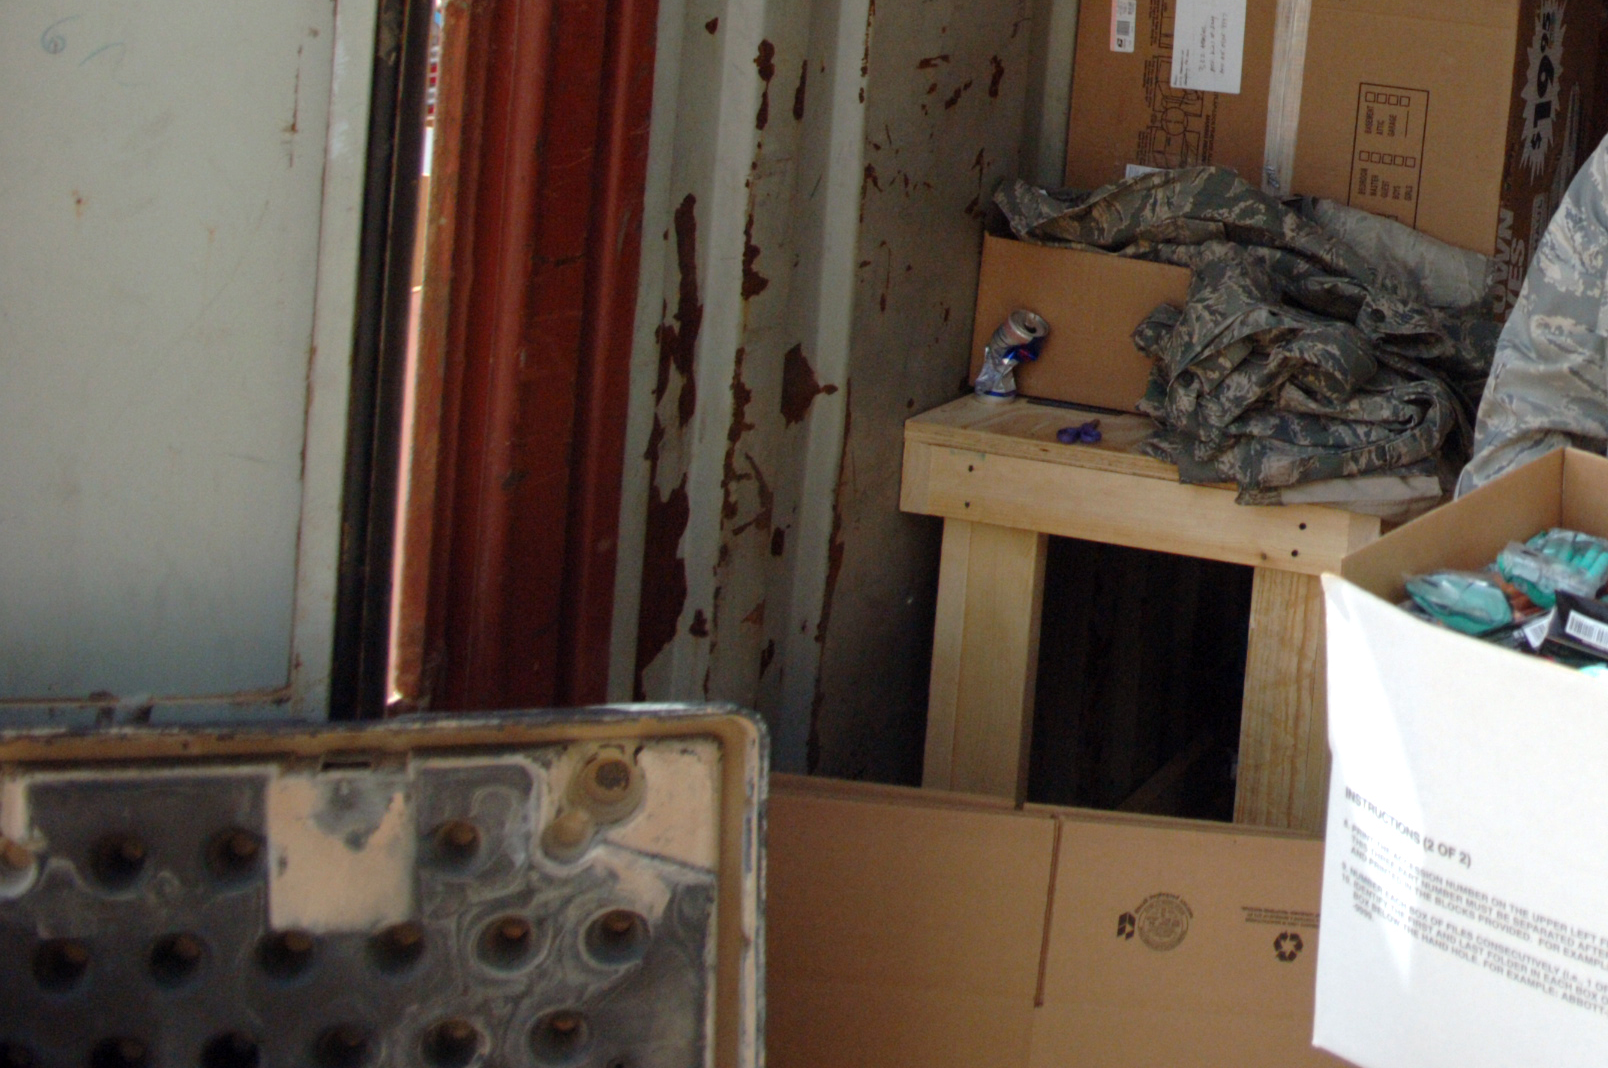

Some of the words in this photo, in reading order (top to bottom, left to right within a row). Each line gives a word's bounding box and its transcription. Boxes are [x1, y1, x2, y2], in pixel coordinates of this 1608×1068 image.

[1365, 105, 1374, 134] BASEMENT
[1376, 120, 1384, 135] ATTIC
[1388, 114, 1396, 136] GARAGE
[1358, 168, 1368, 194] BEDROOM
[1370, 174, 1378, 196] MASTER
[1345, 785, 1421, 845] INSTRUCTIONS
[1423, 836, 1435, 853] (2
[1438, 842, 1457, 860] OF
[1459, 851, 1472, 869] 2)
[1350, 866, 1383, 896] NUMBER
[1409, 905, 1428, 923] BOX
[1430, 915, 1445, 928] OF
[1446, 922, 1474, 942] FILES
[1476, 934, 1561, 977] CONSECUTIVELY
[1351, 846, 1367, 863] AND
[1415, 886, 1433, 902] THE
[1434, 895, 1476, 921] BLOCKS
[1538, 936, 1561, 953] FOR
[1353, 891, 1370, 908] BOX
[1372, 902, 1400, 927] BELOW
[1404, 923, 1419, 940] THE
[1421, 932, 1450, 952] HAND
[1483, 958, 1505, 976] FOR
[1421, 879, 1463, 905] NUMBER
[1465, 897, 1494, 916] MUST
[1496, 910, 1511, 924] BE
[1512, 915, 1575, 948] SEPARATED
[1446, 878, 1489, 903] NUMBER
[1491, 896, 1507, 911] ON
[1510, 903, 1529, 920] THE
[1532, 912, 1568, 933] UPPER
[1570, 926, 1597, 945] LEFT
[1354, 880, 1389, 909] IDENTIFY
[1407, 915, 1434, 935] FIRST
[1436, 929, 1458, 946] AND
[1459, 938, 1485, 957] LAST
[1487, 950, 1530, 975] FOLDER
[1544, 972, 1574, 993] EACH
[1576, 984, 1599, 1002] BOX
